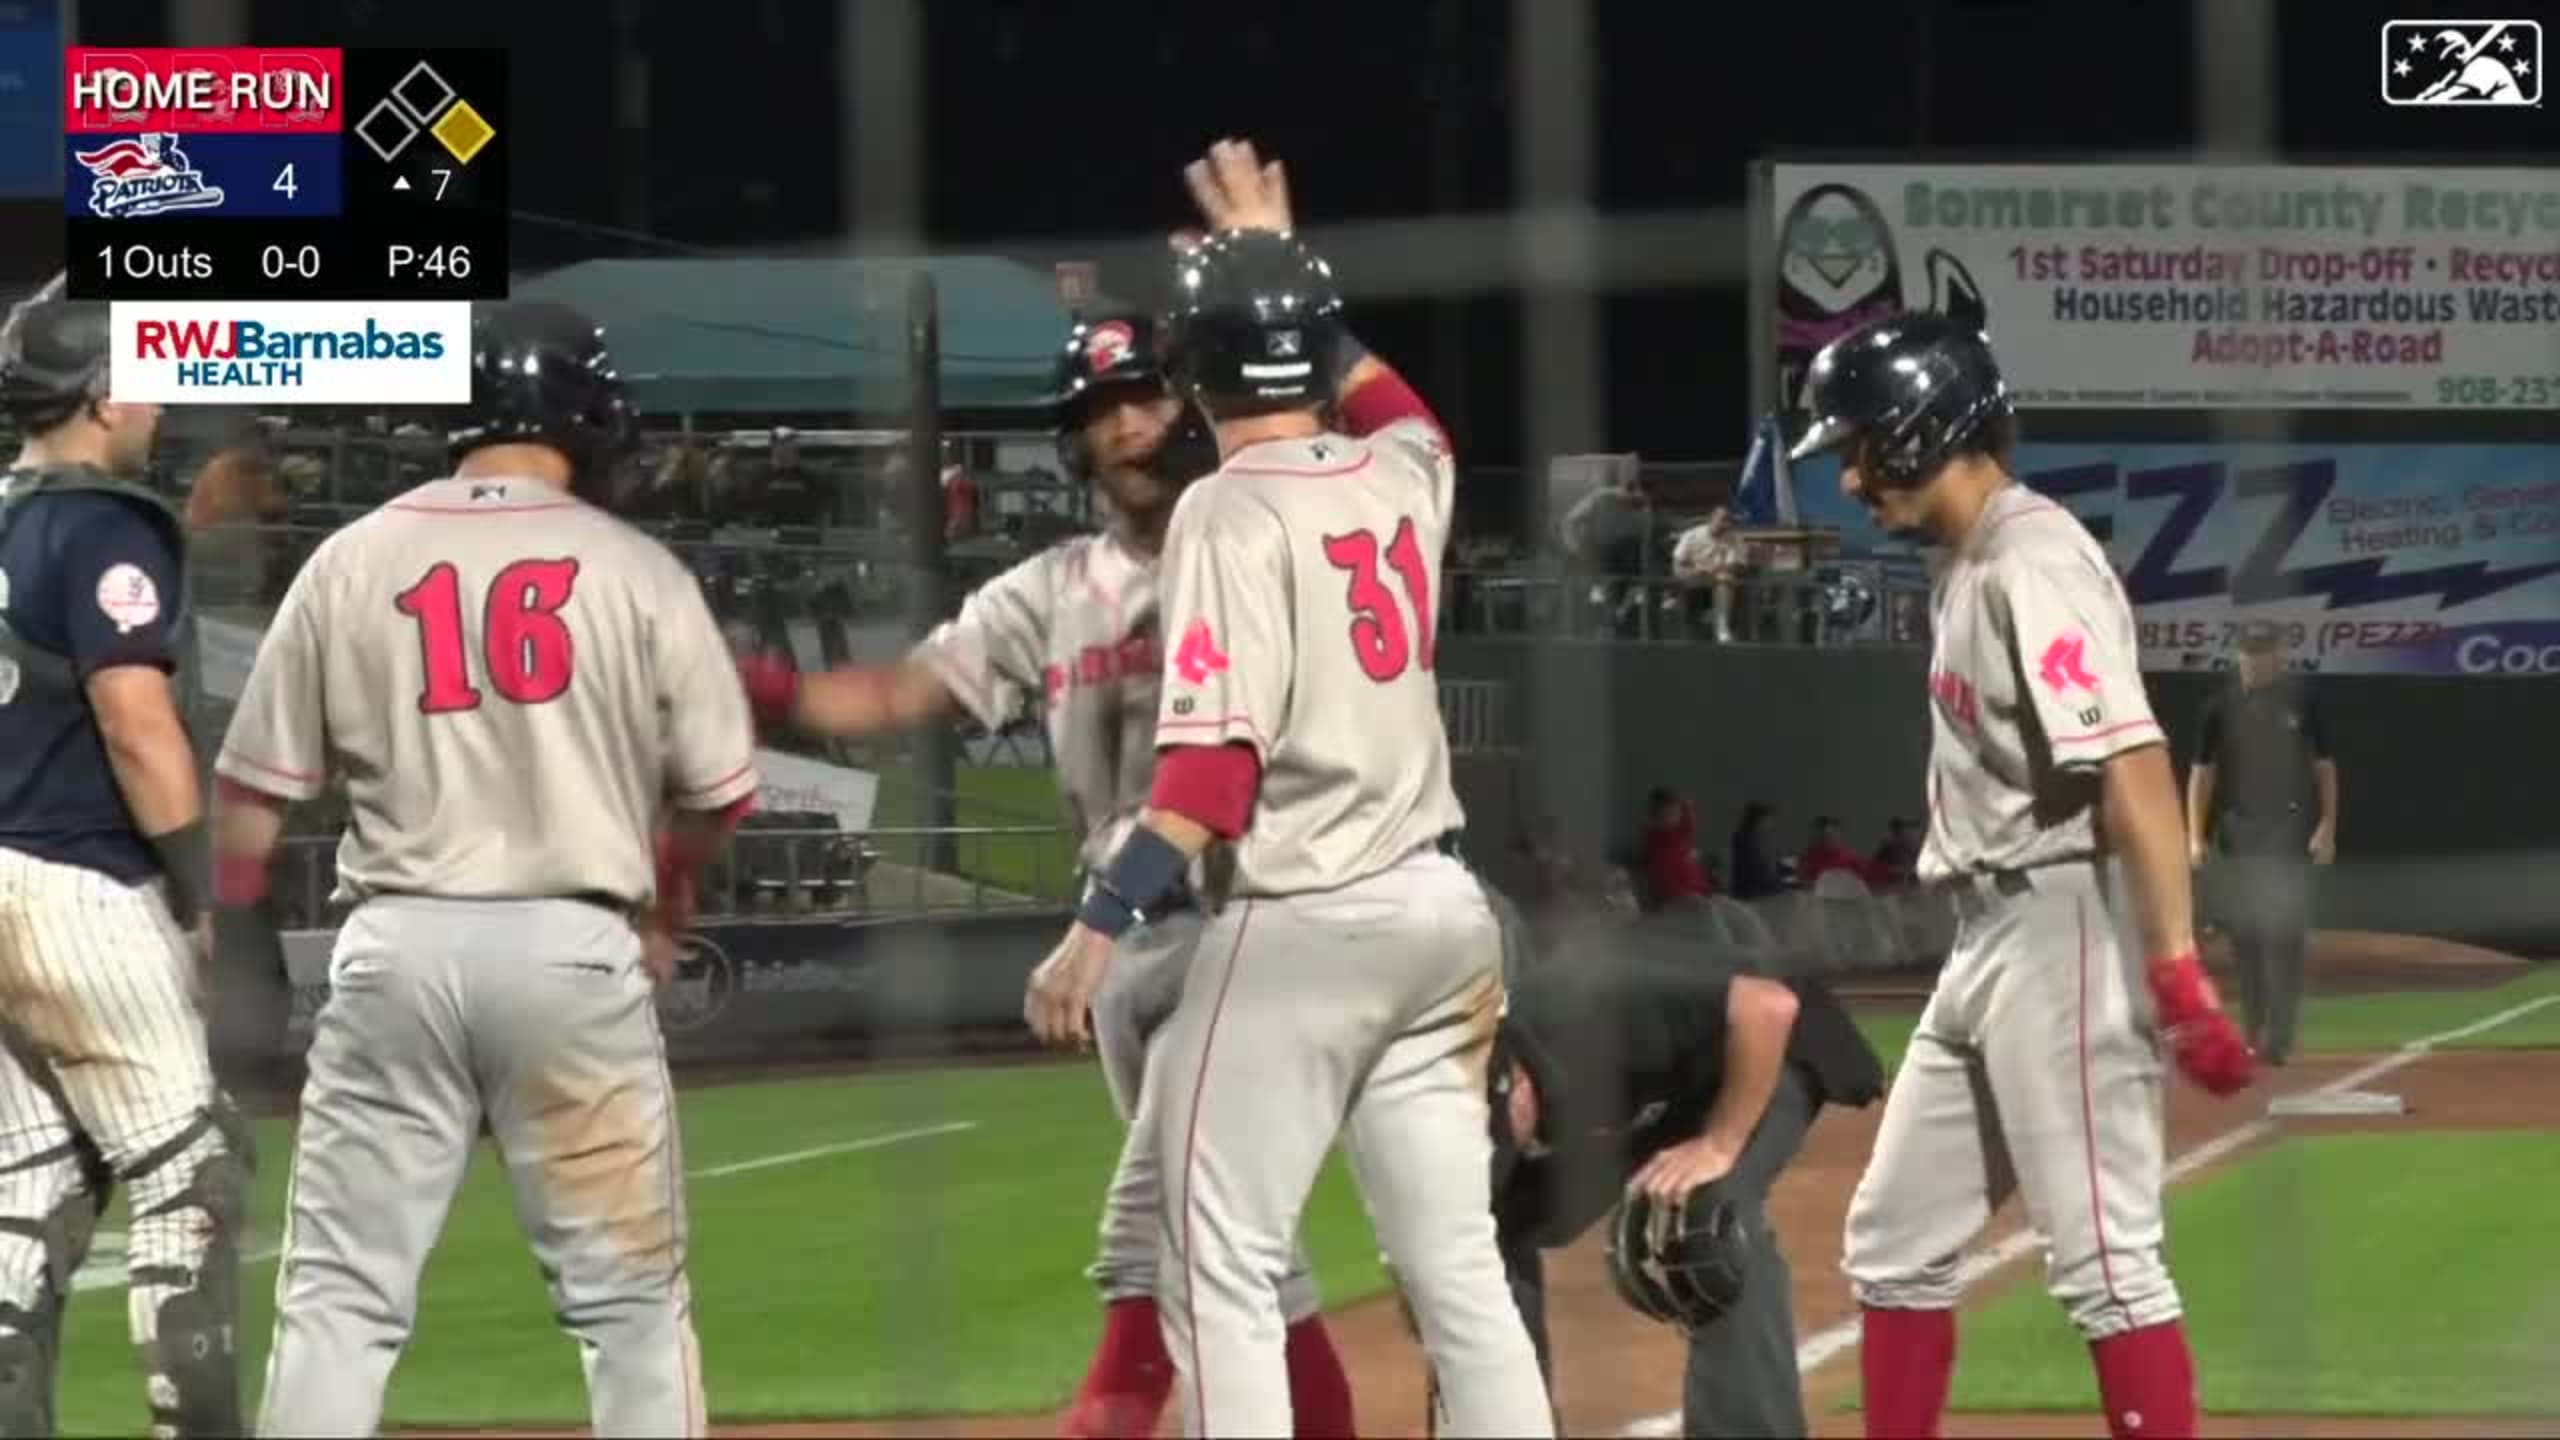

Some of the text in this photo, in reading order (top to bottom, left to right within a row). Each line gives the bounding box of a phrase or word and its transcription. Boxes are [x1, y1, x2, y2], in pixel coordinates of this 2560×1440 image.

[1903, 181, 2174, 228] Somerset
[2191, 183, 2385, 236] County
[2011, 246, 2069, 281] 1st
[2080, 246, 2243, 286] Saturday
[2259, 247, 2416, 287] Drop-Off
[2053, 287, 2560, 322] Household Hazardous Wast
[2192, 329, 2443, 367] Adopt-A-Road
[1322, 516, 1436, 683] 31
[395, 556, 579, 714] 16
